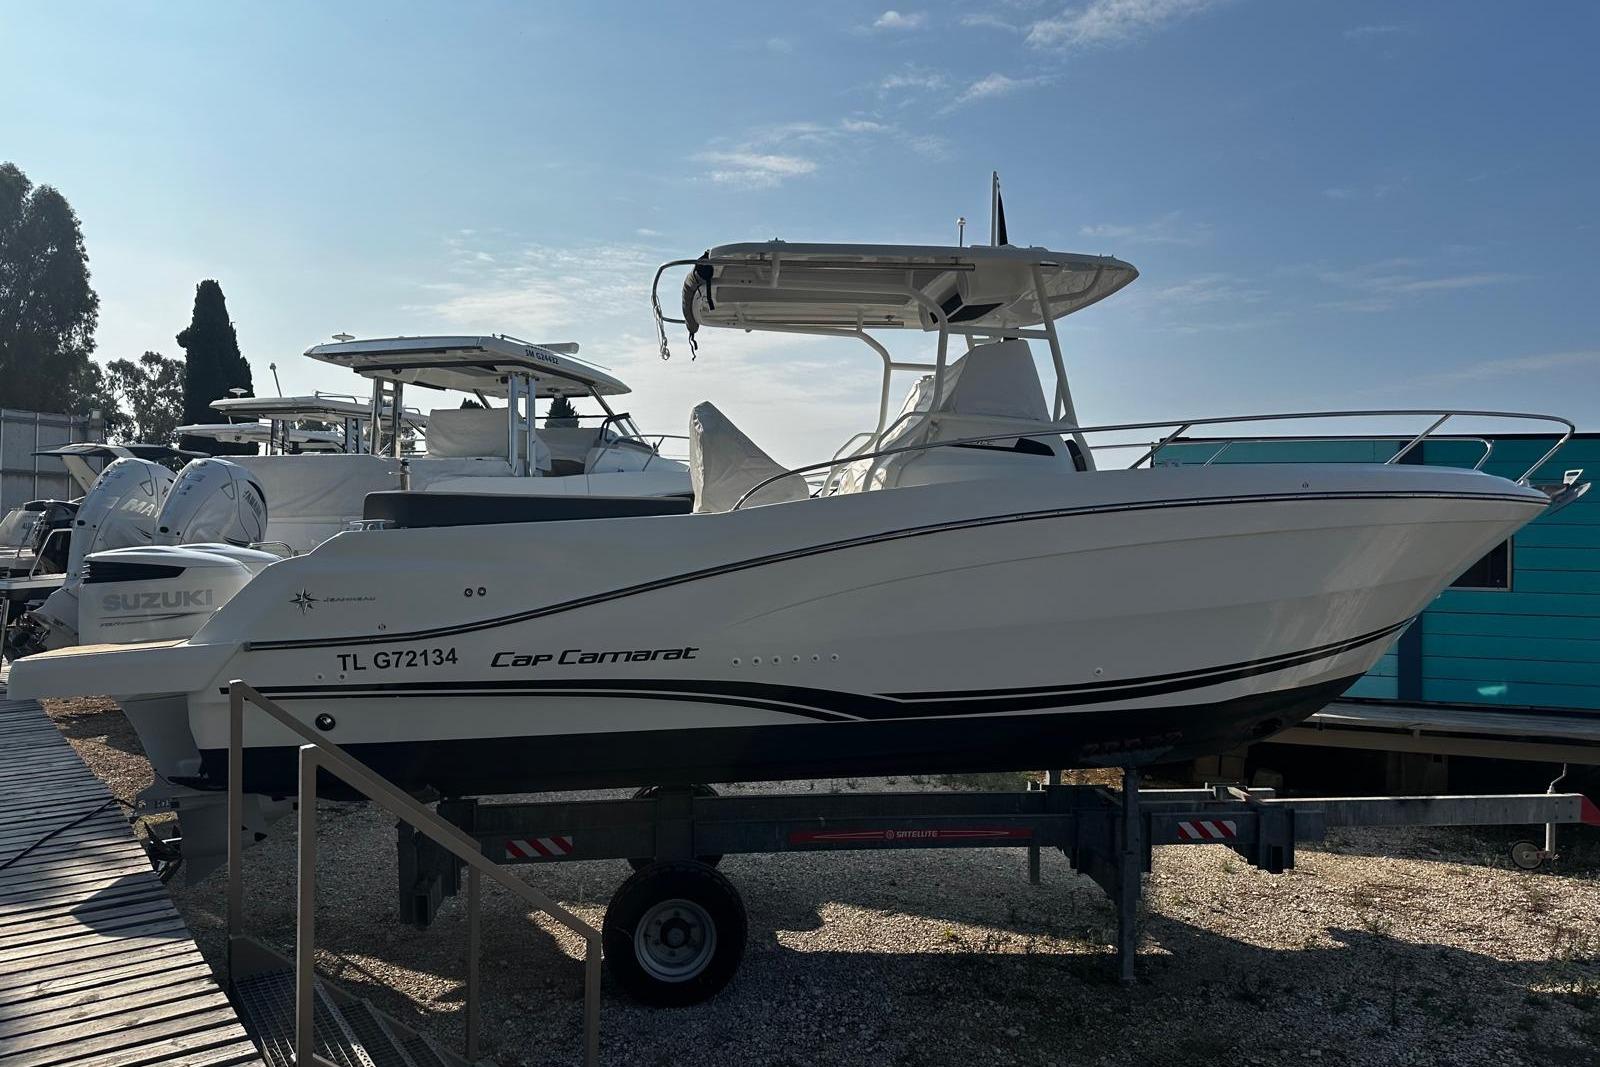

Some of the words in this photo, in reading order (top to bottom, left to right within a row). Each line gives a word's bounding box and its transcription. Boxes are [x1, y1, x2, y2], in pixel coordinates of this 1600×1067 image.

[102, 589, 213, 611] SUZUKI
[337, 653, 367, 671] TL
[373, 647, 458, 669] G72134
[557, 647, 700, 665] Camarat
